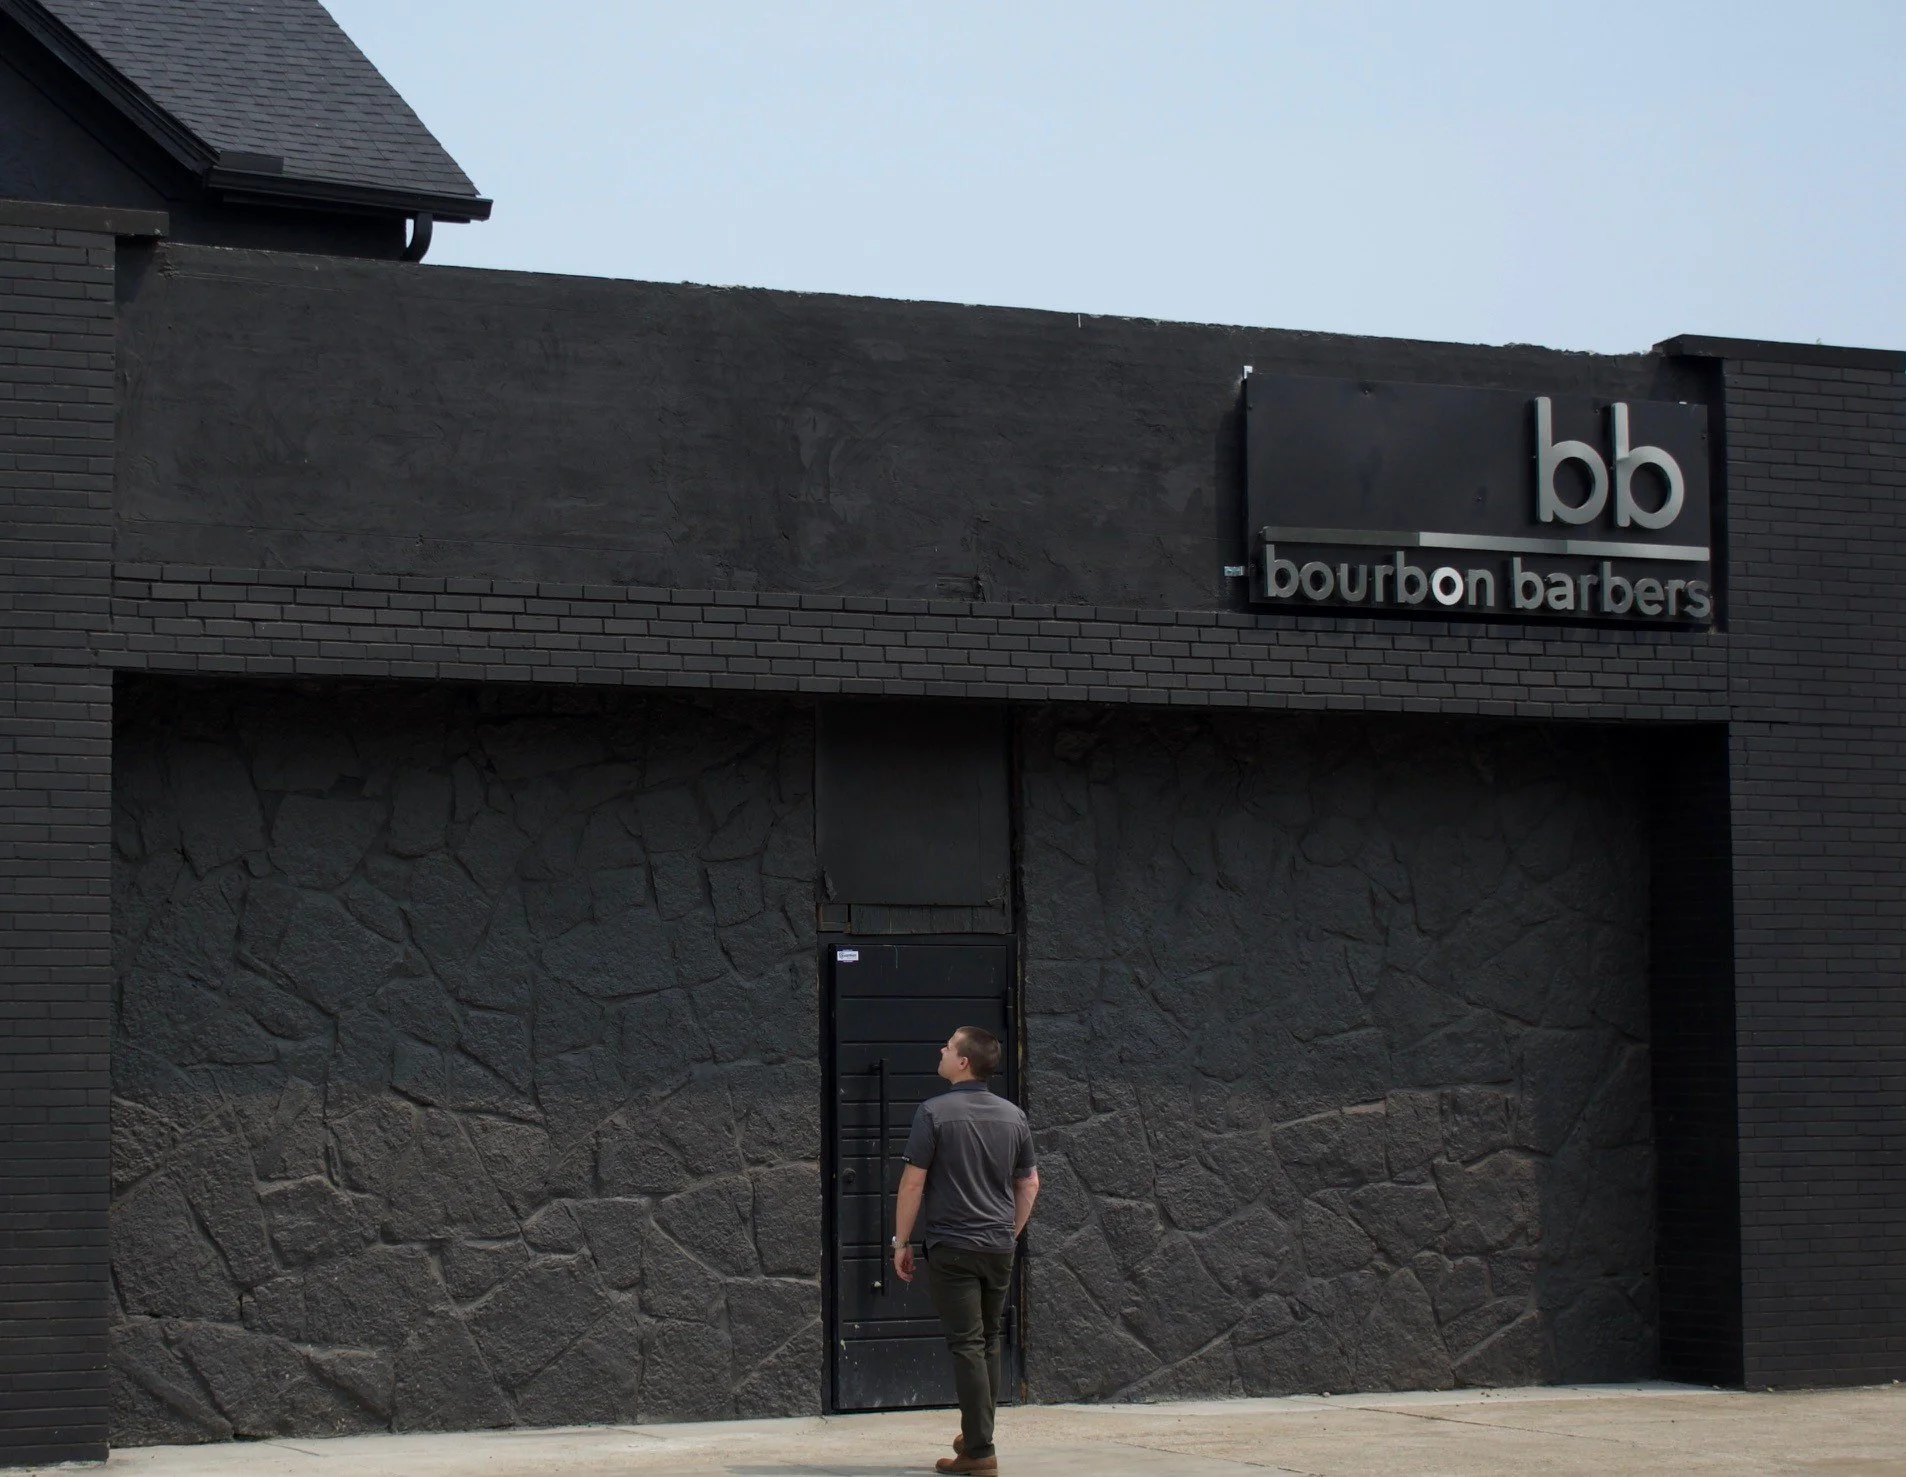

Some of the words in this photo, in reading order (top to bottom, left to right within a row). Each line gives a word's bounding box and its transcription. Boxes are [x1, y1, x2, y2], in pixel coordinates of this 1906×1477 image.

[1535, 396, 1685, 529] bb
[1264, 544, 1495, 607] bourbon
[1512, 556, 1711, 617] barbers
